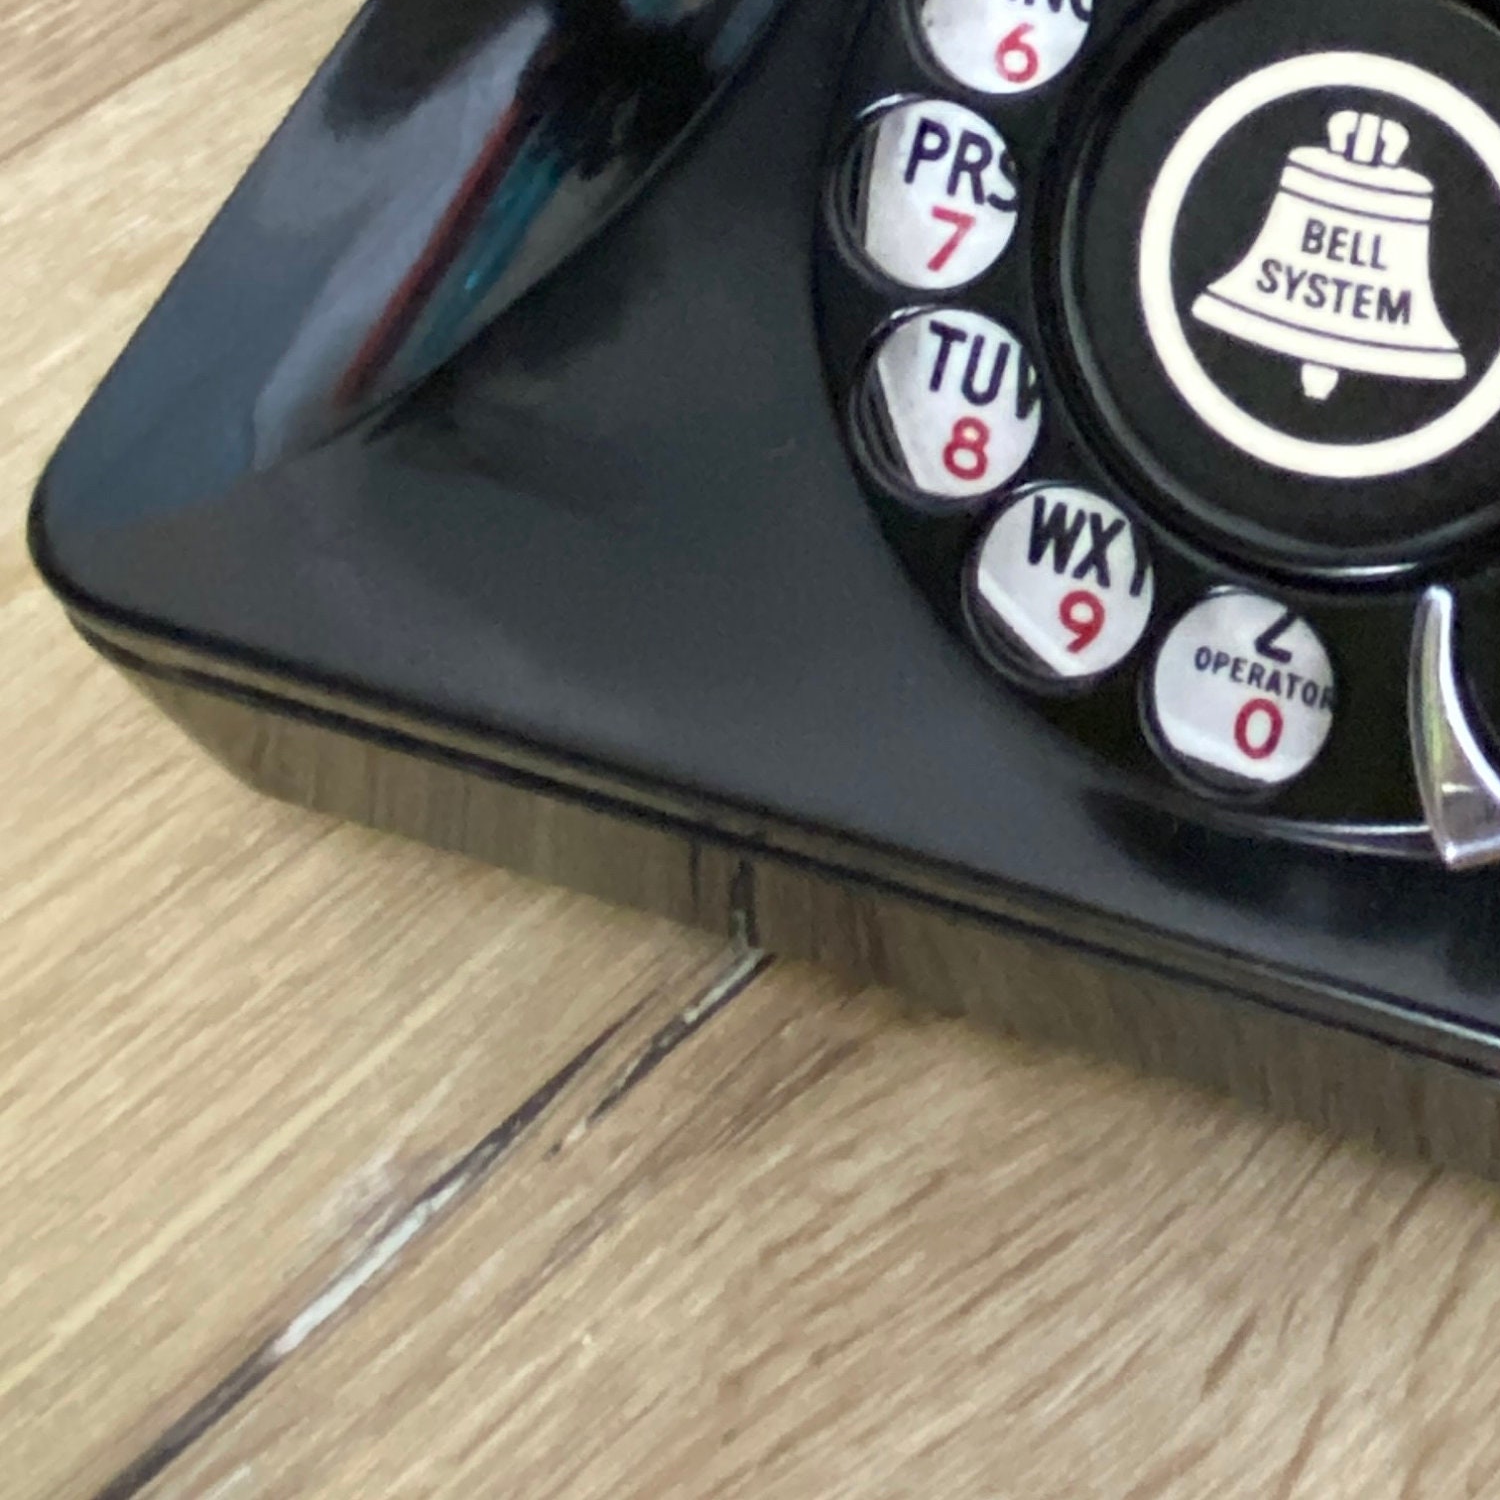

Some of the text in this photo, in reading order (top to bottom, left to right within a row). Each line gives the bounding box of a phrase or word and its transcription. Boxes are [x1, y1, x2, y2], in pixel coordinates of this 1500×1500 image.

[995, 23, 1039, 83] 6
[927, 206, 976, 272] 7
[1301, 218, 1388, 271] BELL
[1256, 258, 1413, 326] SYSTEM
[943, 416, 990, 480] 8
[1058, 589, 1105, 654] 9
[1233, 698, 1284, 760] 0
